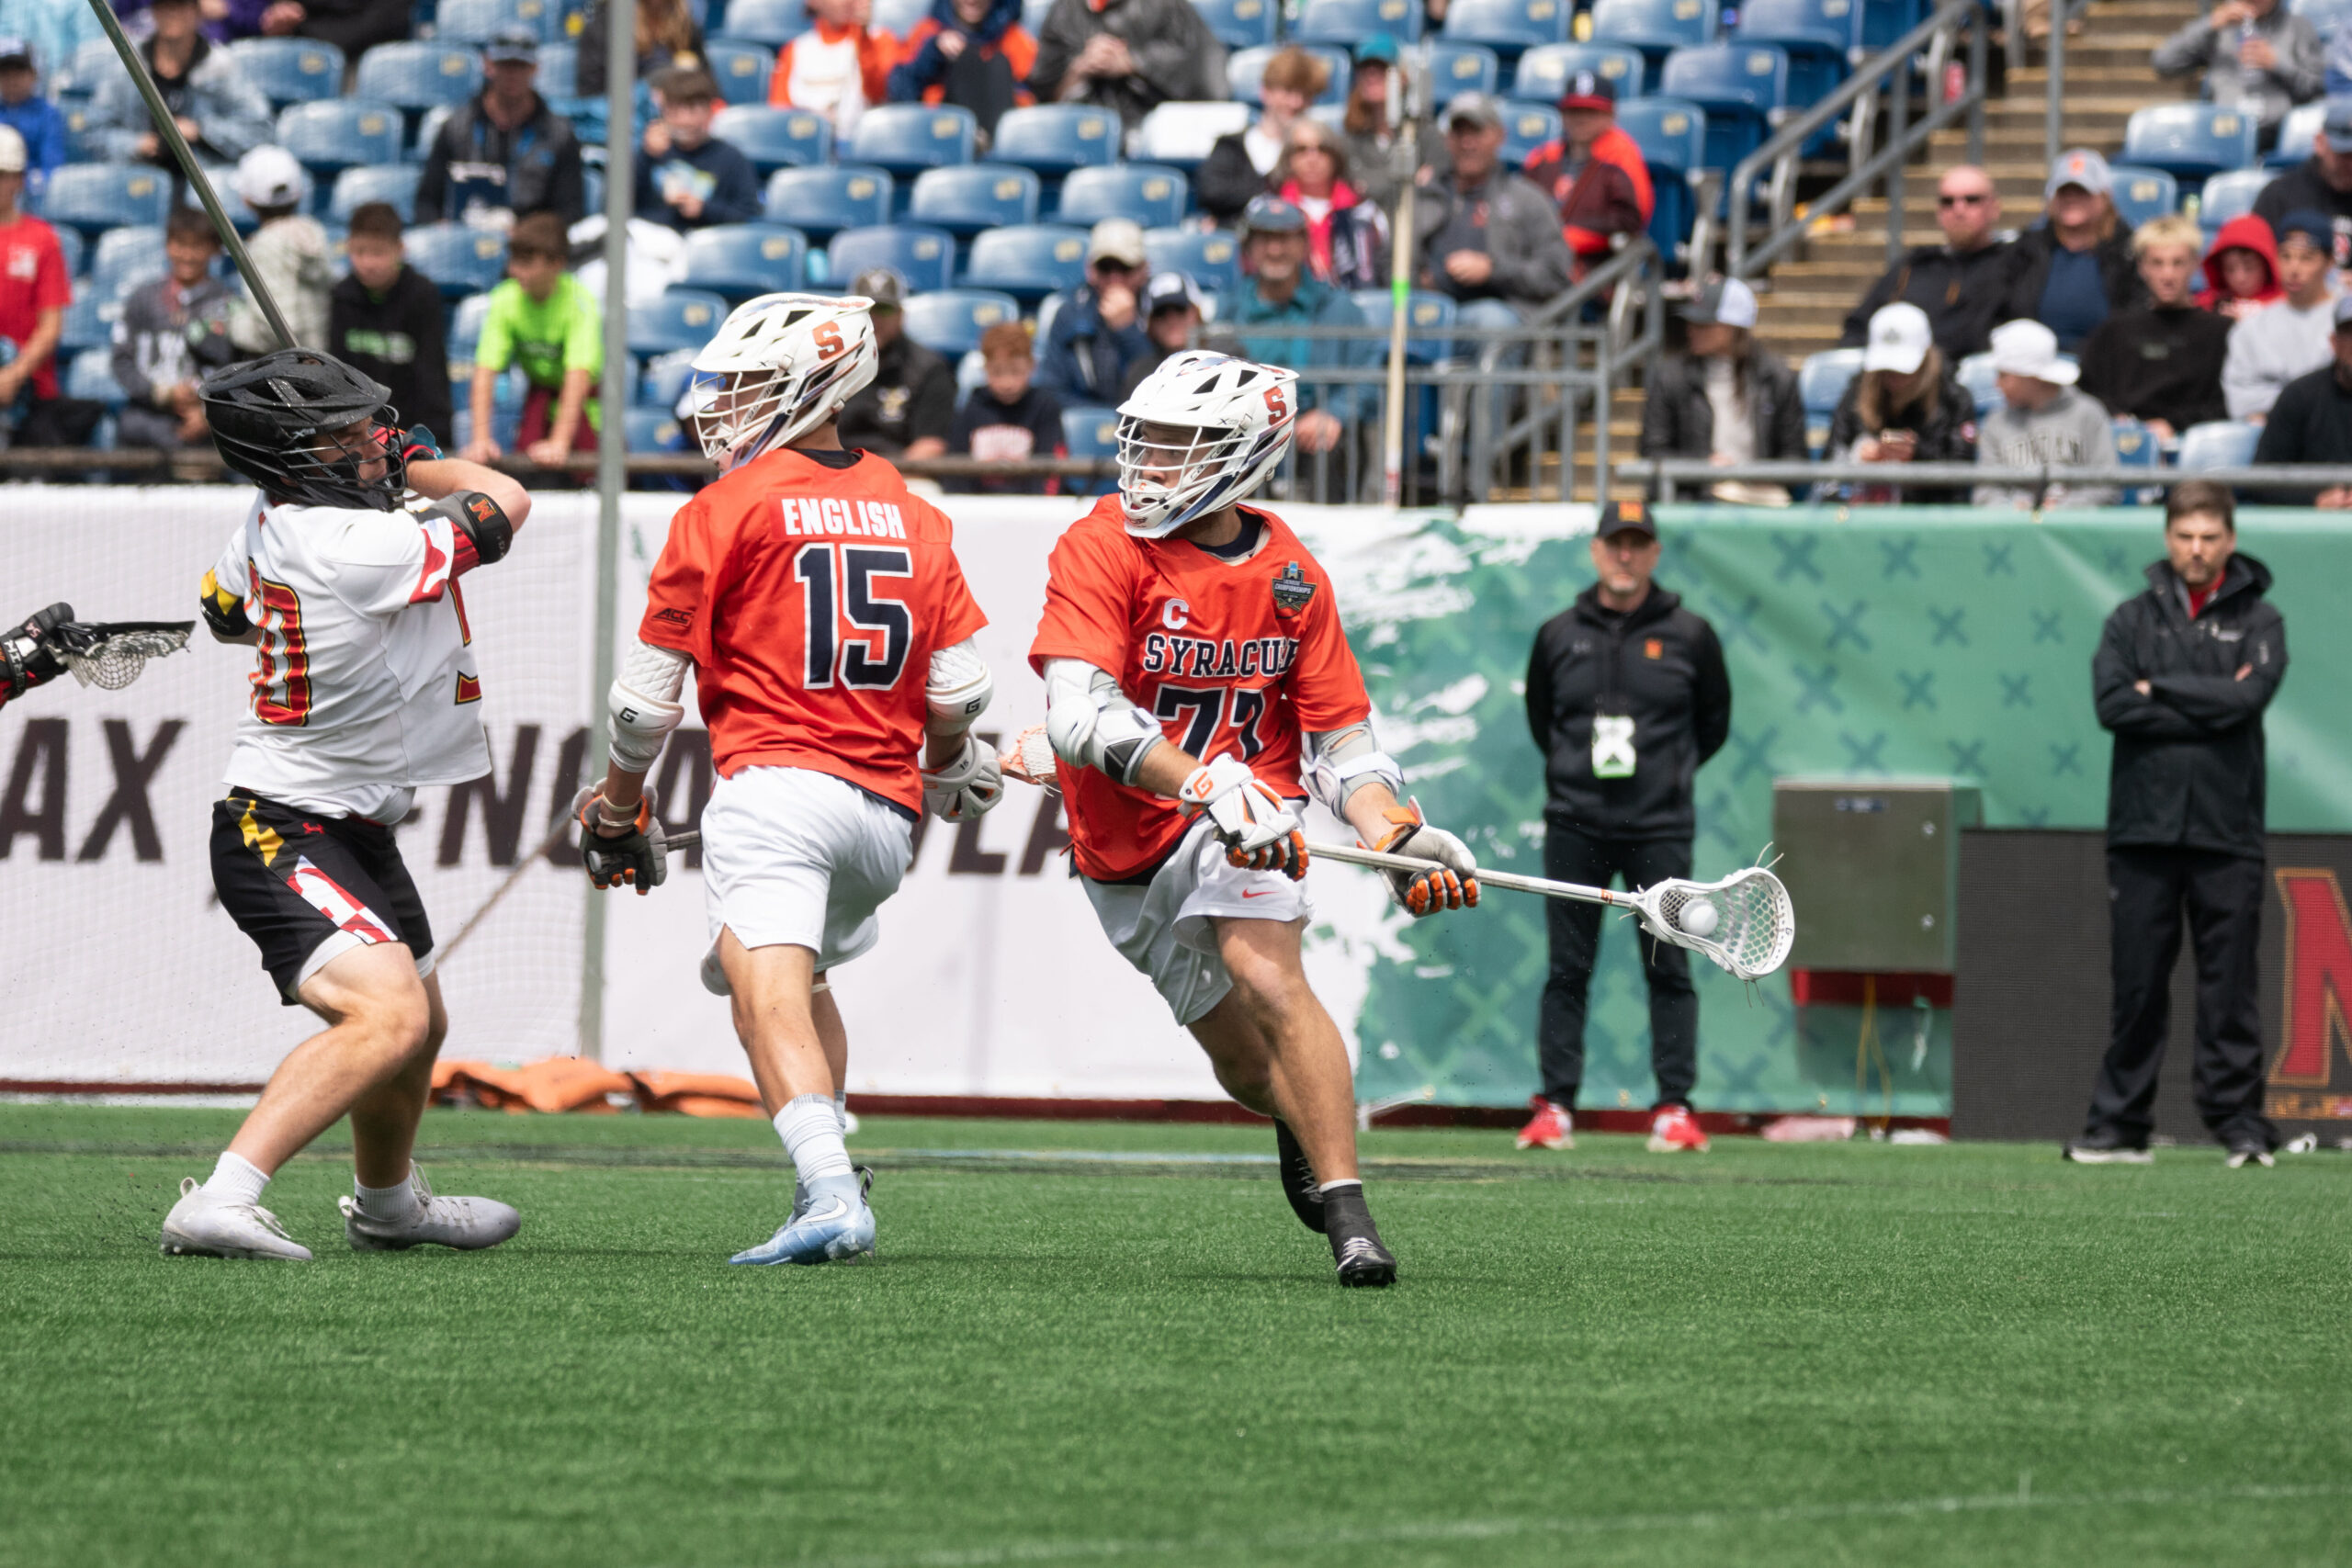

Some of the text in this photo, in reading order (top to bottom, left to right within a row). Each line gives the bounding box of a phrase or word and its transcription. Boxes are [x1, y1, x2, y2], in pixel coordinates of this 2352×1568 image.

[813, 321, 845, 361] S
[1263, 386, 1287, 426] S
[782, 498, 907, 539] ENGLISH
[794, 543, 913, 691] 15
[1162, 598, 1189, 630] C
[619, 706, 639, 724] G
[965, 697, 981, 715] G
[1193, 771, 1214, 799] G
